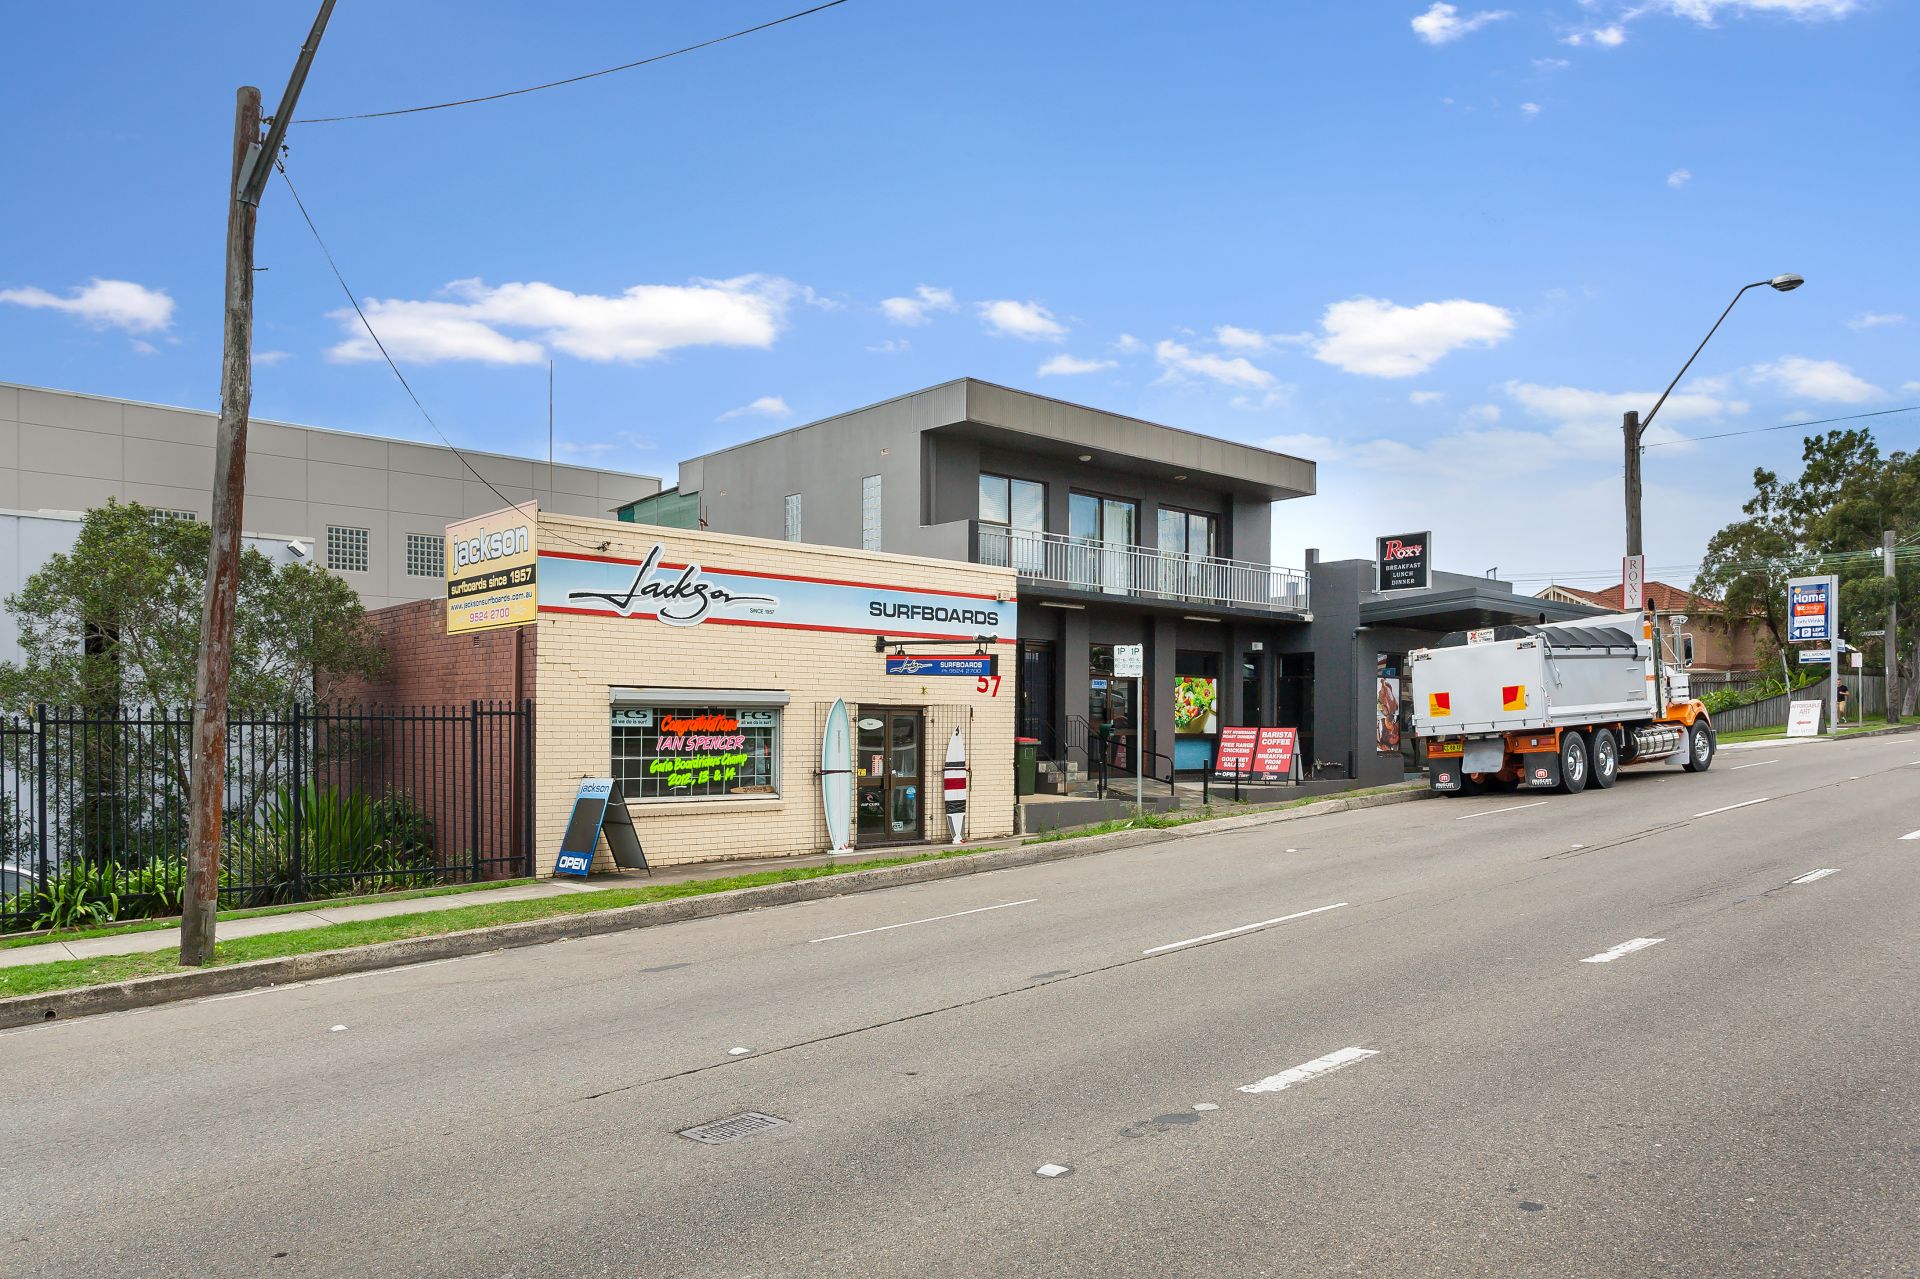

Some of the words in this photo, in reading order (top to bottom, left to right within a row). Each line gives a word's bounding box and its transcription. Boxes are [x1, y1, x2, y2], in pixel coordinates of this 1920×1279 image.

[453, 525, 528, 575] jackson
[1385, 562, 1421, 571] BREAKFAST
[451, 577, 487, 595] surfboards
[488, 575, 508, 588] since
[510, 567, 532, 584] 1957
[569, 545, 774, 620] Jackson
[1391, 578, 1415, 586] DINNER
[1628, 559, 1638, 604] ROXY
[1794, 593, 1826, 603] Home
[469, 610, 488, 623] 9524
[490, 607, 510, 620] 2700
[869, 601, 999, 626] SURFBOARDS
[940, 661, 983, 669] SURFBOARDS
[976, 675, 1002, 697] 57
[612, 709, 648, 719] FCS
[741, 711, 772, 719] FCS
[656, 735, 683, 751] IAN
[685, 735, 746, 752] SPENCER
[721, 752, 748, 767] Champ
[698, 770, 710, 785] 13
[714, 769, 721, 781] &
[725, 767, 737, 781] 14
[580, 782, 610, 794] jackson
[559, 855, 588, 871] OPEN
